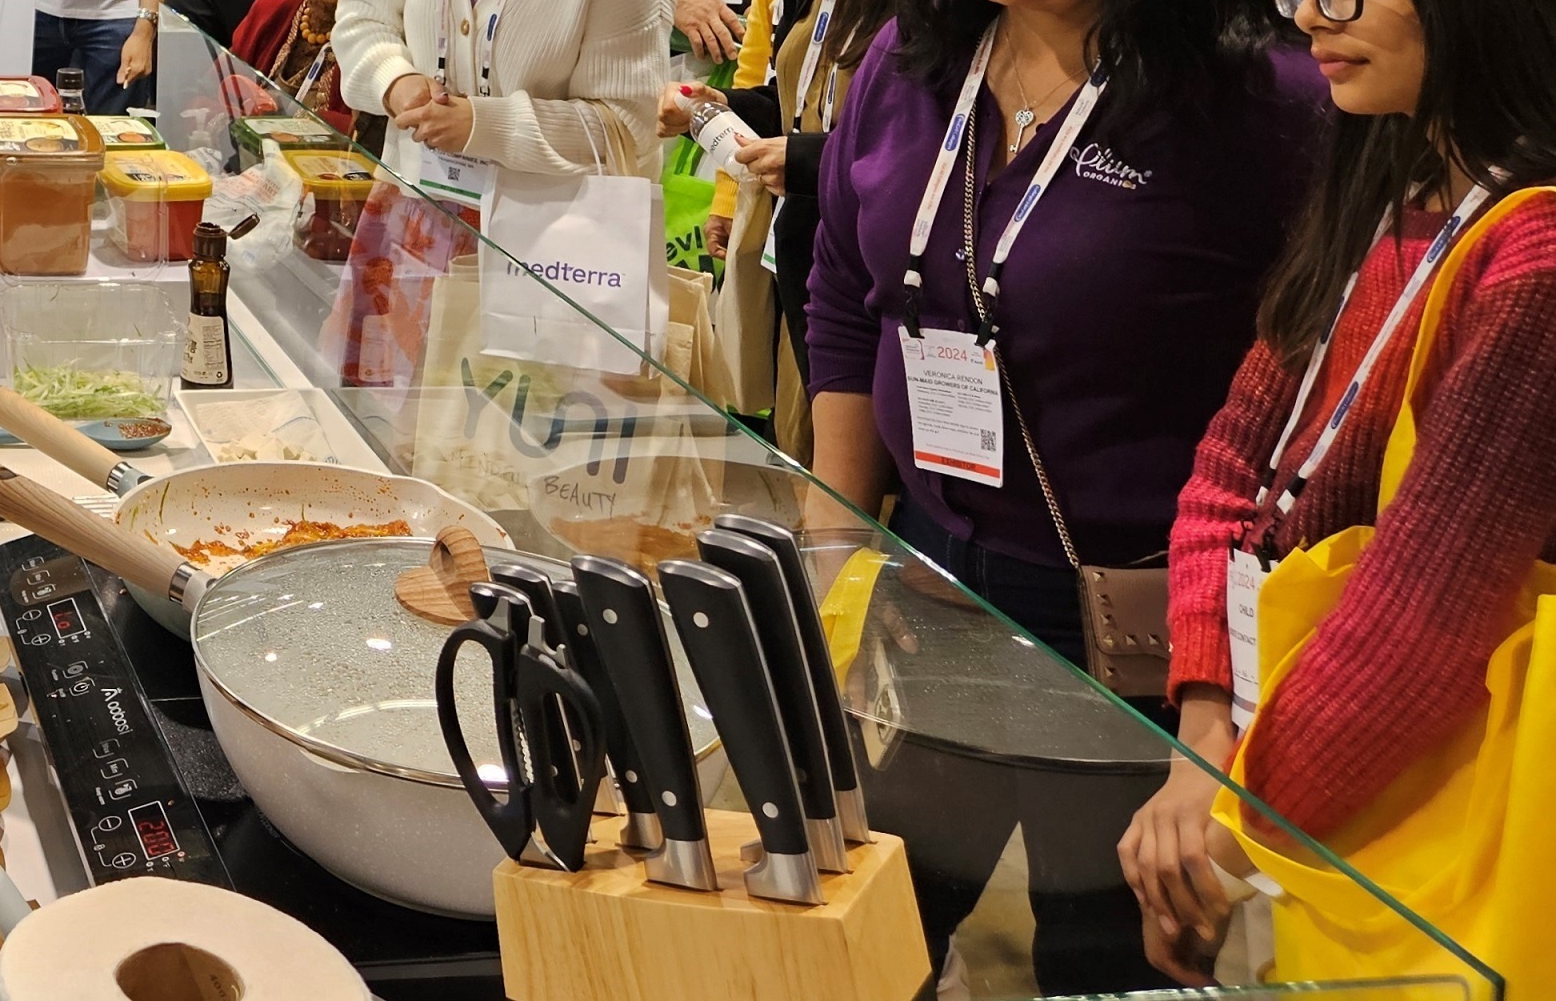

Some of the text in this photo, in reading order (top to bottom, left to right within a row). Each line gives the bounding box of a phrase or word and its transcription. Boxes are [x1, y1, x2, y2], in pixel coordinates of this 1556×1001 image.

[506, 259, 623, 288] medterra
[937, 345, 968, 362] 2024
[923, 369, 984, 385] VERONICA RENDON
[544, 475, 617, 520] BEAUTY
